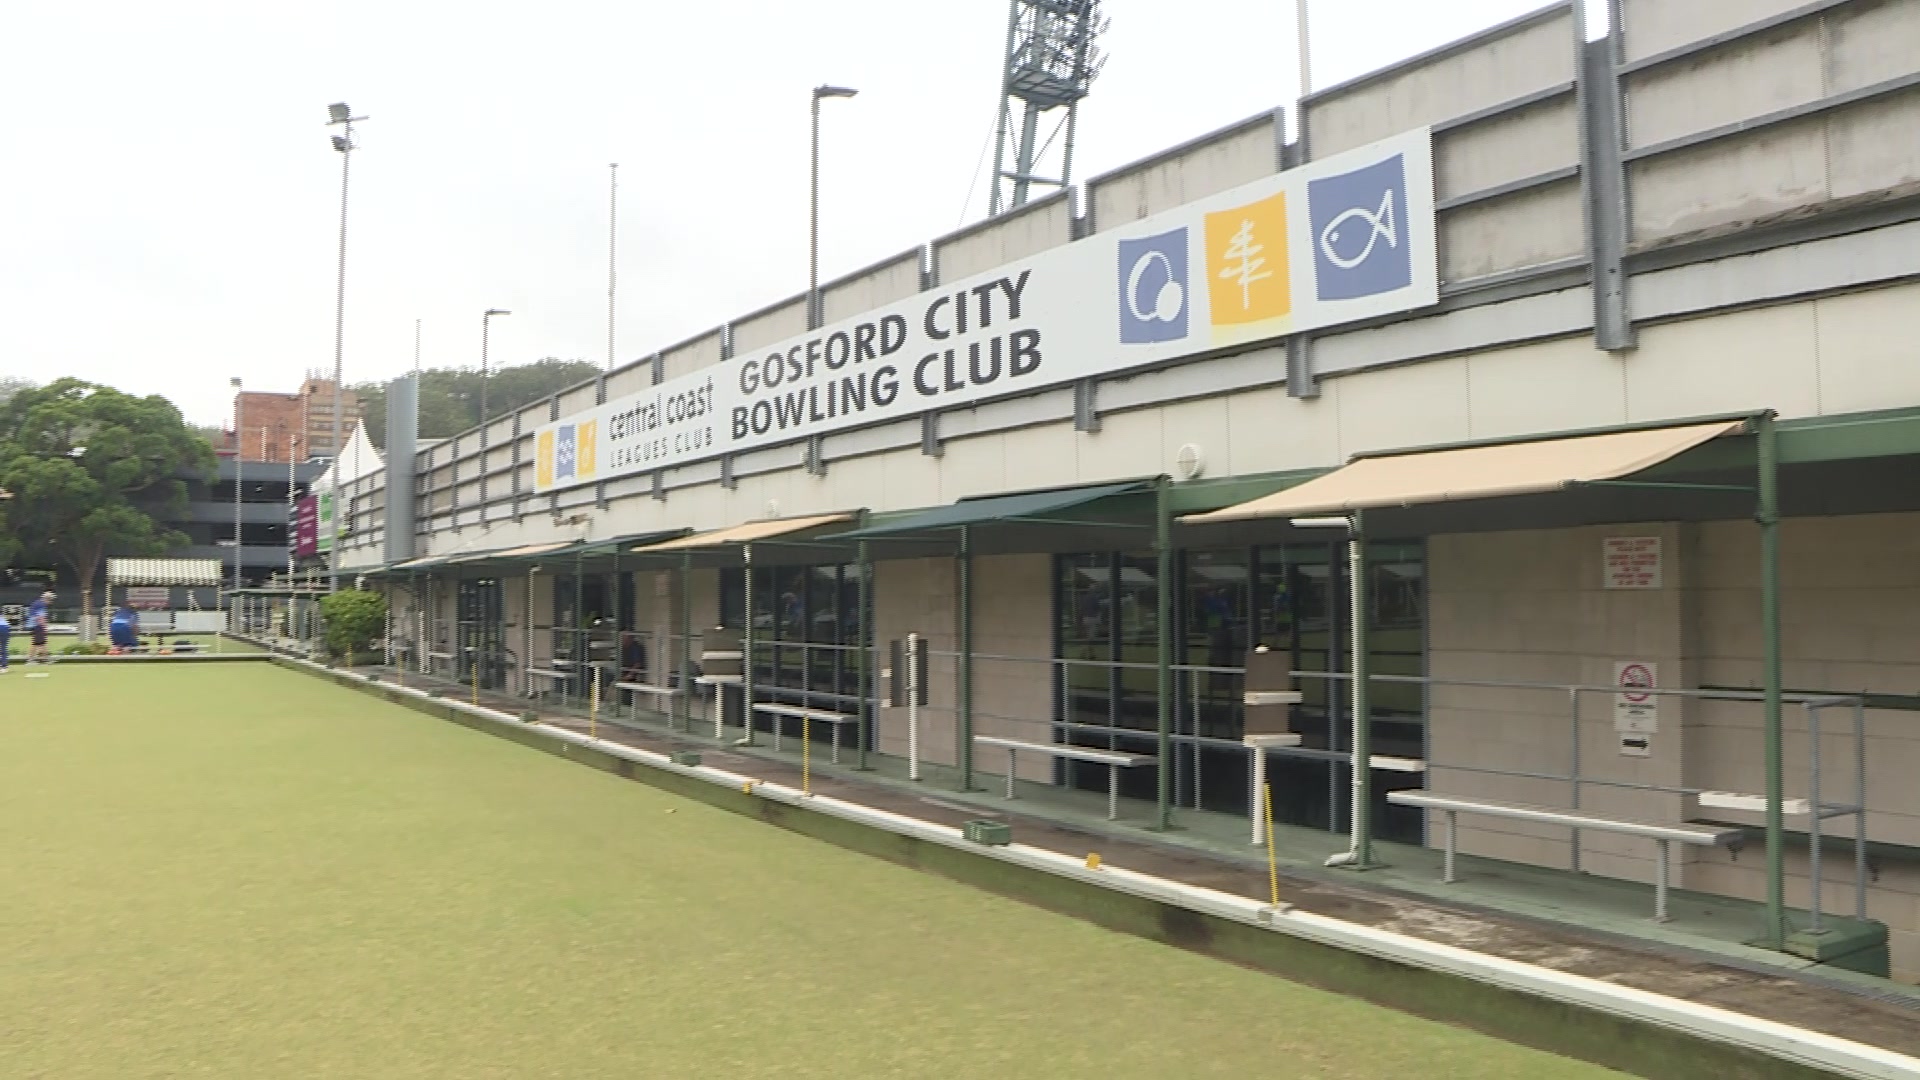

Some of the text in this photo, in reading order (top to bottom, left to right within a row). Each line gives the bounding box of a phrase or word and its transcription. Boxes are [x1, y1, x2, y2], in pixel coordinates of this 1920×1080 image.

[739, 269, 1032, 396] GOSFORD CITY
[609, 375, 713, 441] central coast
[731, 328, 1042, 440] BOWLING CLUB
[610, 426, 712, 469] LEAGUES CLUB
